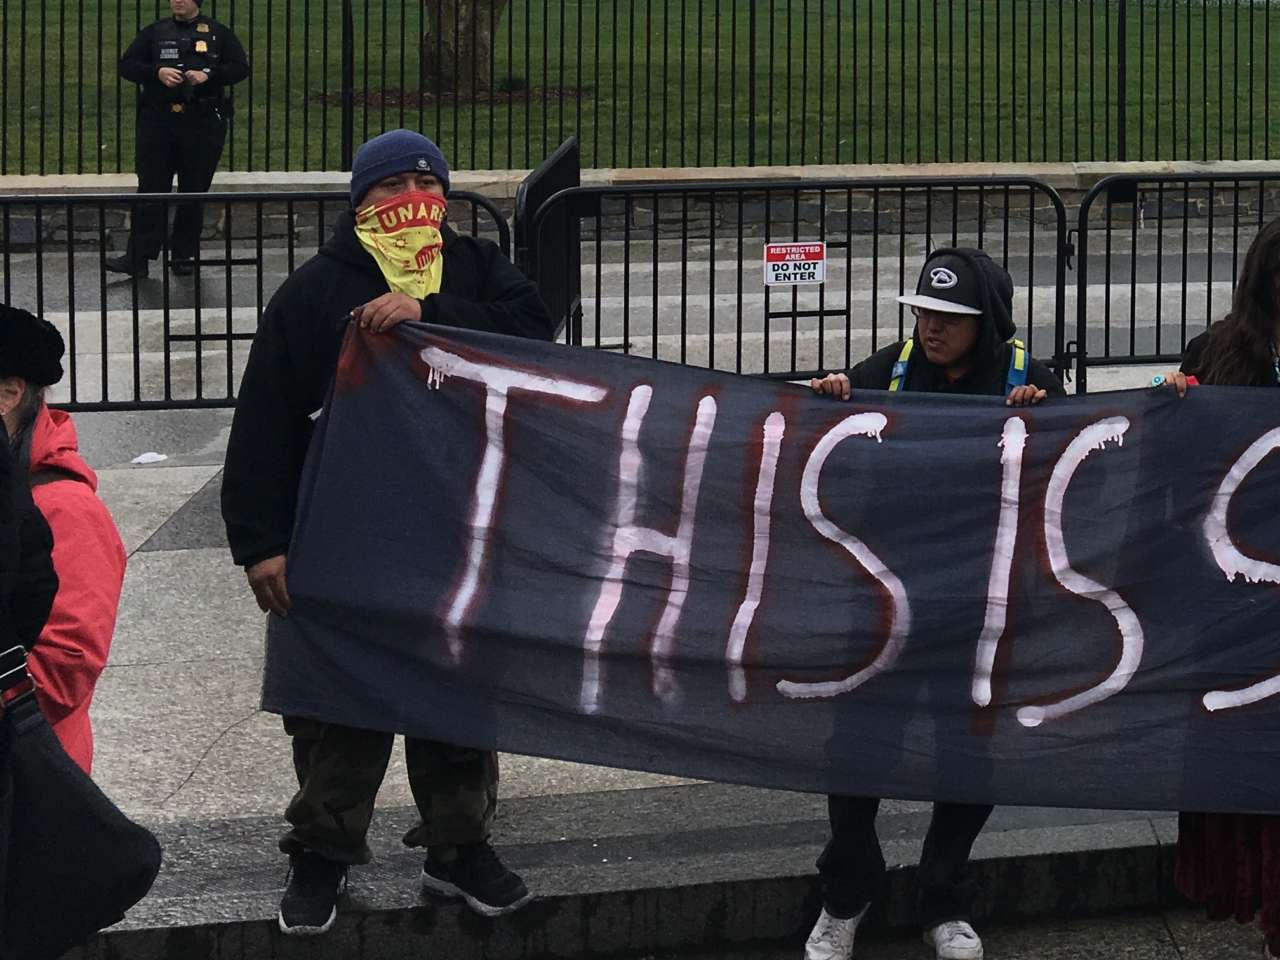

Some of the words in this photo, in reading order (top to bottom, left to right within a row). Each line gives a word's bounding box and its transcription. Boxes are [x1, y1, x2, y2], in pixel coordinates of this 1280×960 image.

[770, 246, 821, 254] RESTRICTED
[785, 253, 806, 261] AREA
[772, 263, 790, 272] DO
[793, 262, 819, 271] NOT
[775, 271, 816, 281] ENTER
[420, 346, 909, 715] THIS
[972, 416, 1144, 728] IS
